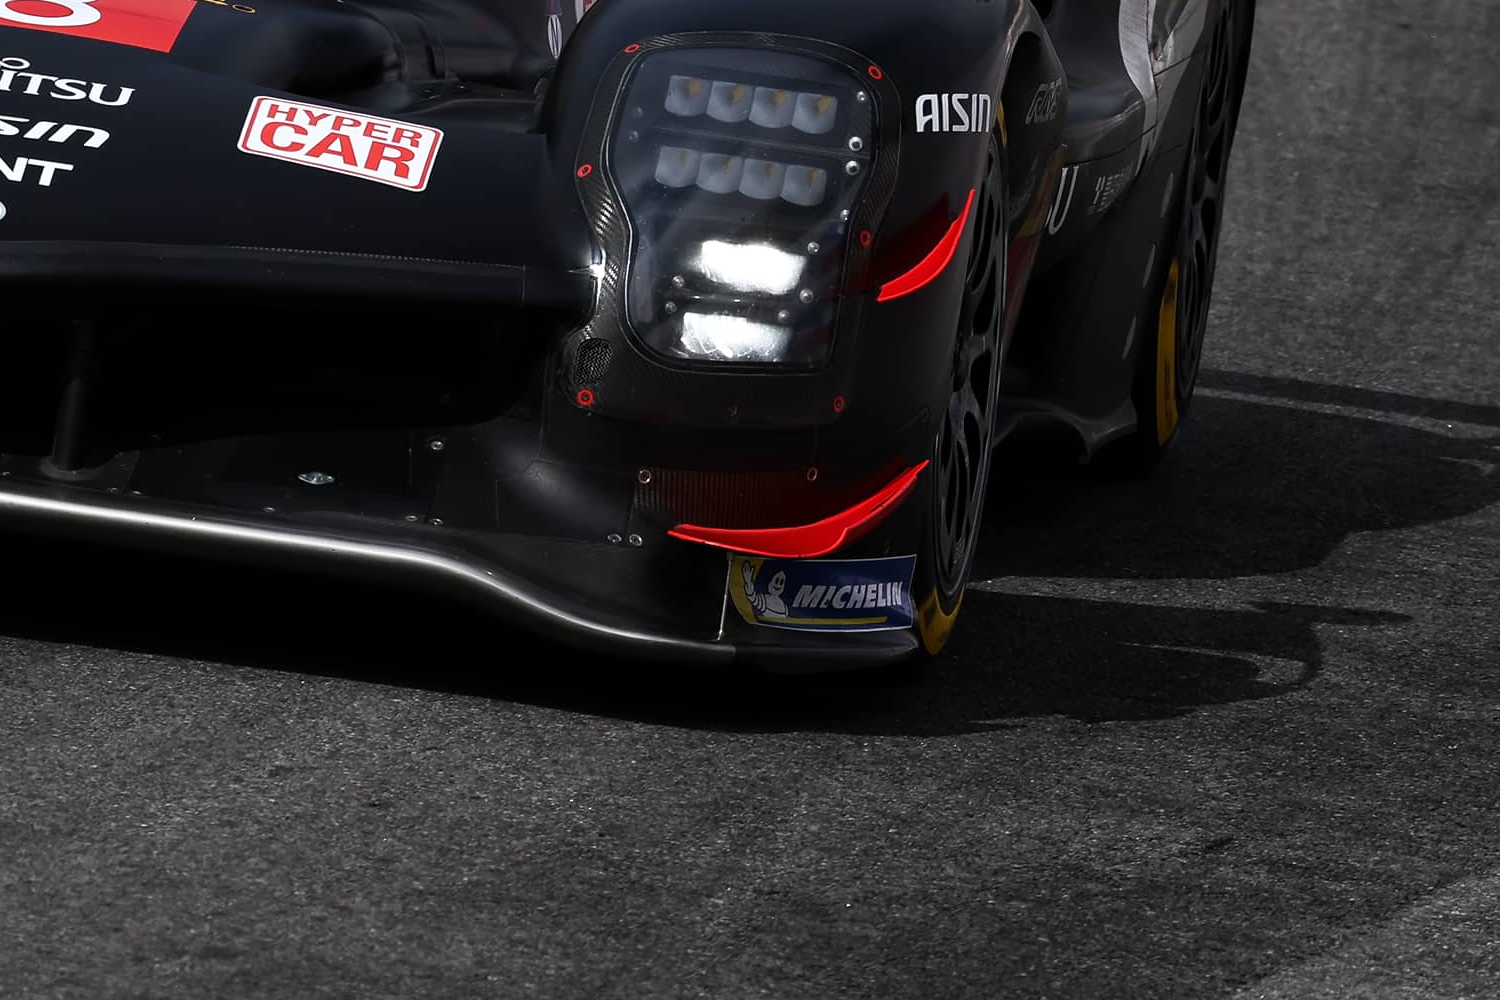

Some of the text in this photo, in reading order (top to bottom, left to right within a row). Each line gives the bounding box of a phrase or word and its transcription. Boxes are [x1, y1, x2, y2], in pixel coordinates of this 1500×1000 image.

[266, 103, 422, 148] HYPER
[915, 93, 991, 133] AISIN
[259, 121, 415, 180] CAR
[792, 580, 904, 609] MICHELIN
